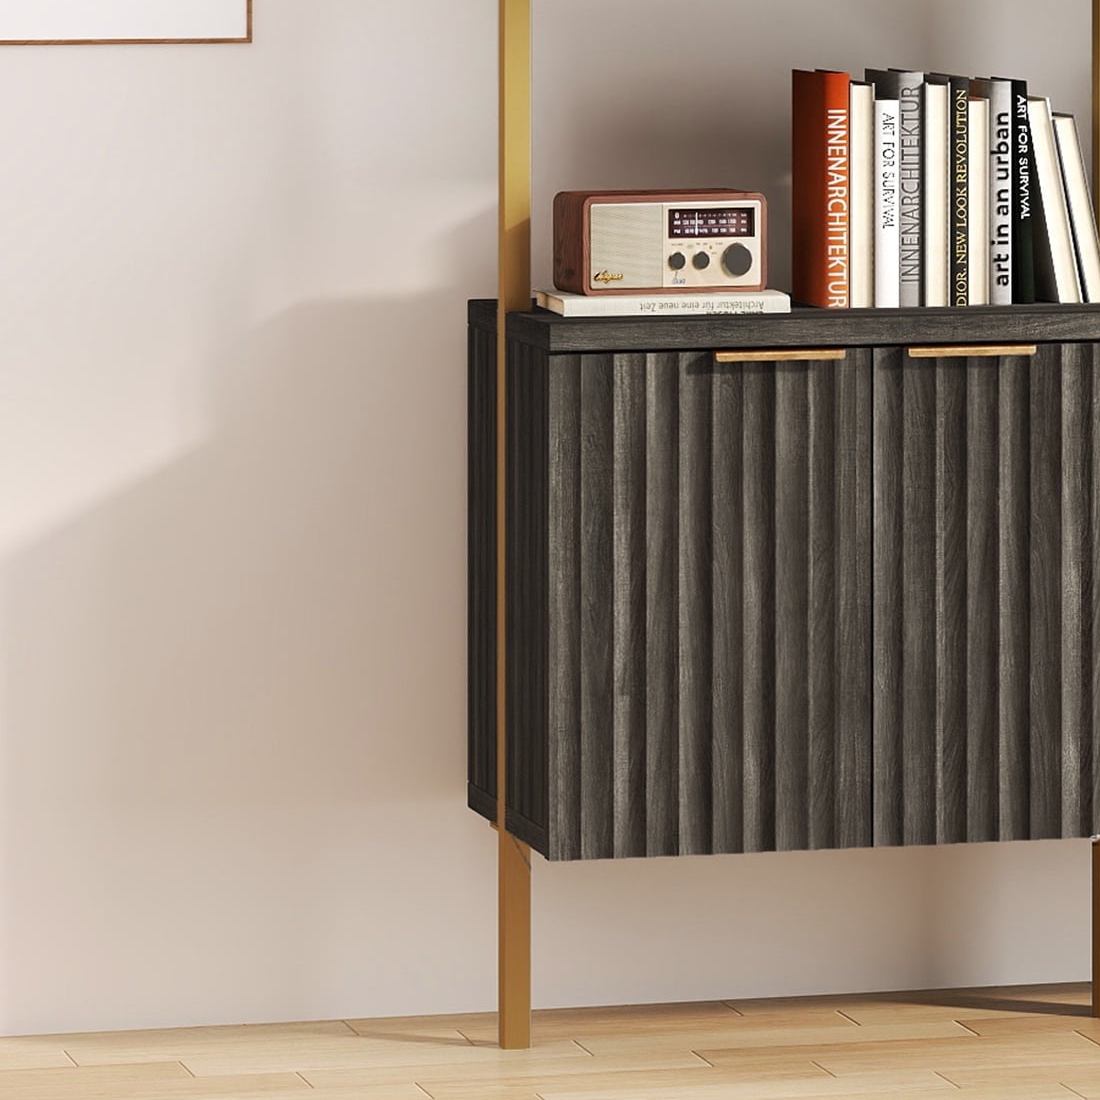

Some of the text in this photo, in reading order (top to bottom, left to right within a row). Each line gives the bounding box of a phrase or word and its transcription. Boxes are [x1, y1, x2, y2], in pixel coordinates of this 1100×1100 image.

[827, 109, 847, 308] INNENARCHITEKTUR
[882, 112, 895, 230] ART FOR SURVIVAL
[901, 86, 920, 283] INNENARCHITEKTUR
[956, 89, 967, 308] DIOR. NEW LOOK REVOLUTION
[990, 112, 1010, 287] art in an urban
[1016, 94, 1031, 220] ART FOR SURVIVAL
[640, 302, 657, 312] Zeit
[659, 302, 679, 311] neue
[681, 302, 700, 310] eine
[717, 300, 765, 312] Architektur
